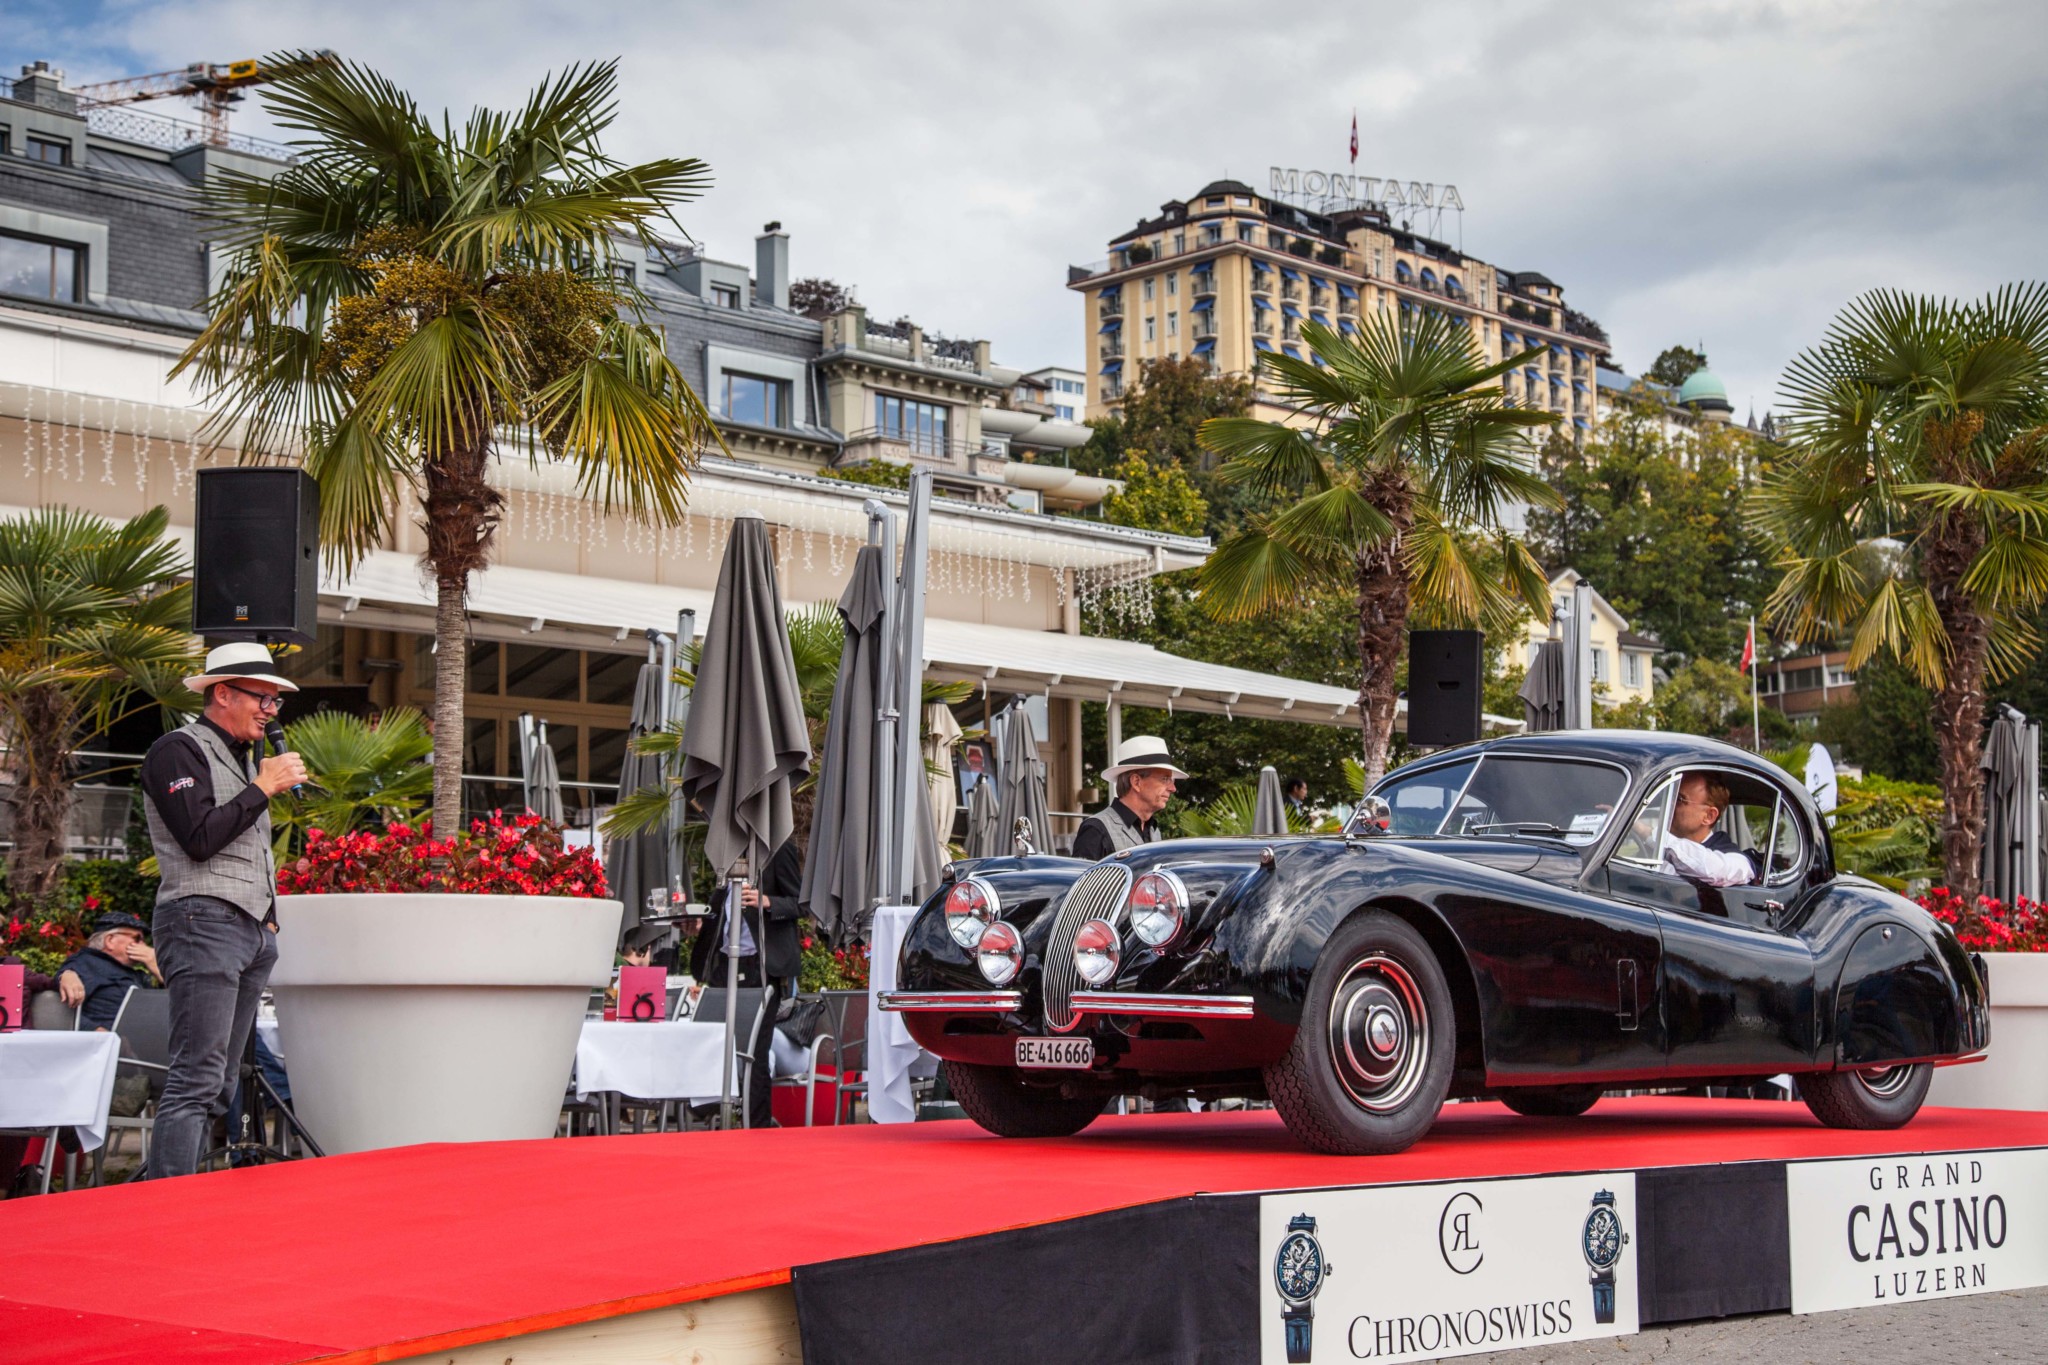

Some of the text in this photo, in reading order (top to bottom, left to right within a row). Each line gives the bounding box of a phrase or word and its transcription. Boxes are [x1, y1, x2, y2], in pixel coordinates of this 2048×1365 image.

[1270, 166, 1465, 211] MONTANA
[1870, 1160, 1982, 1191] GRAND
[1847, 1194, 2007, 1263] CASINO
[1874, 1263, 1986, 1299] LUZERN
[1347, 1299, 1573, 1359] CHRONOSWISS
